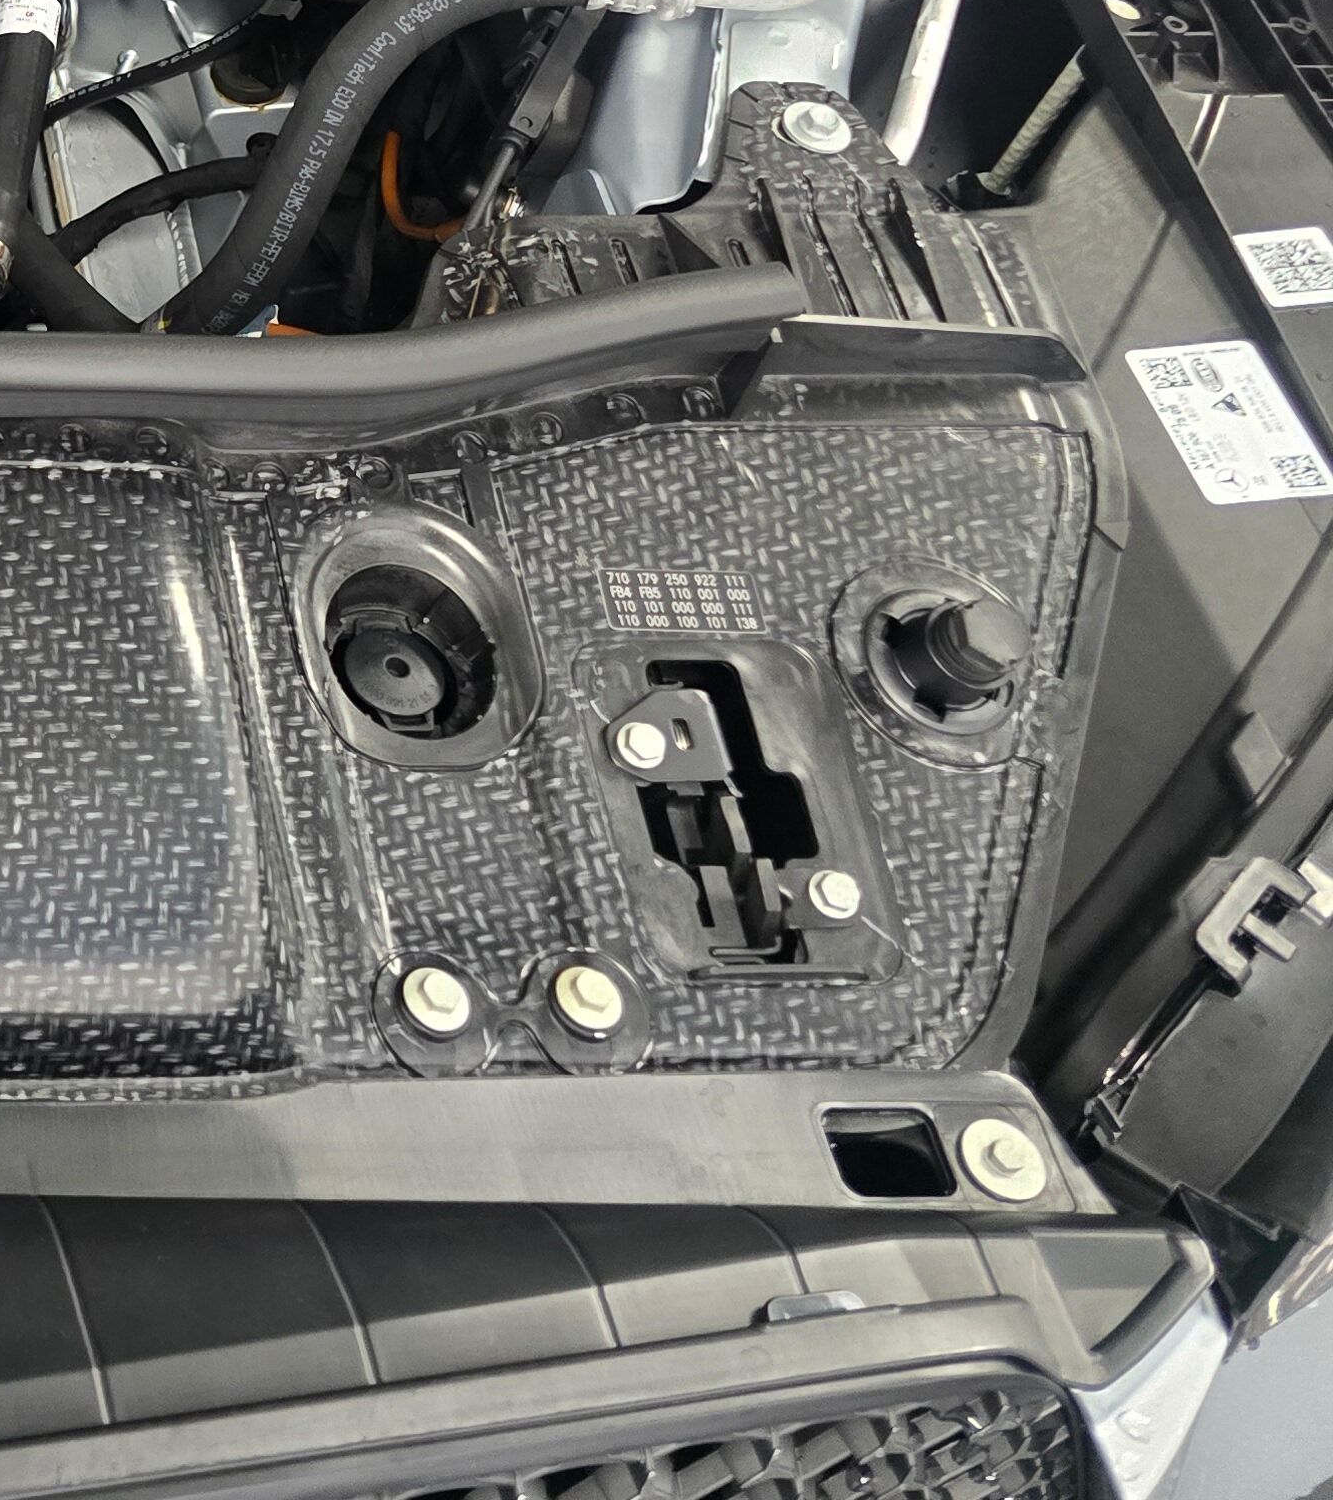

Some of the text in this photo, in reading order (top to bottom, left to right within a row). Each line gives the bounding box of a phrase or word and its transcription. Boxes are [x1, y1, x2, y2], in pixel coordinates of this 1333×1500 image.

[606, 572, 747, 587] 710 179 250 922 111
[610, 585, 751, 601] FB4 FB5 110 001 000
[614, 600, 753, 615] 110 101 000 000 111
[617, 614, 758, 630] 110 000 100 101 138
